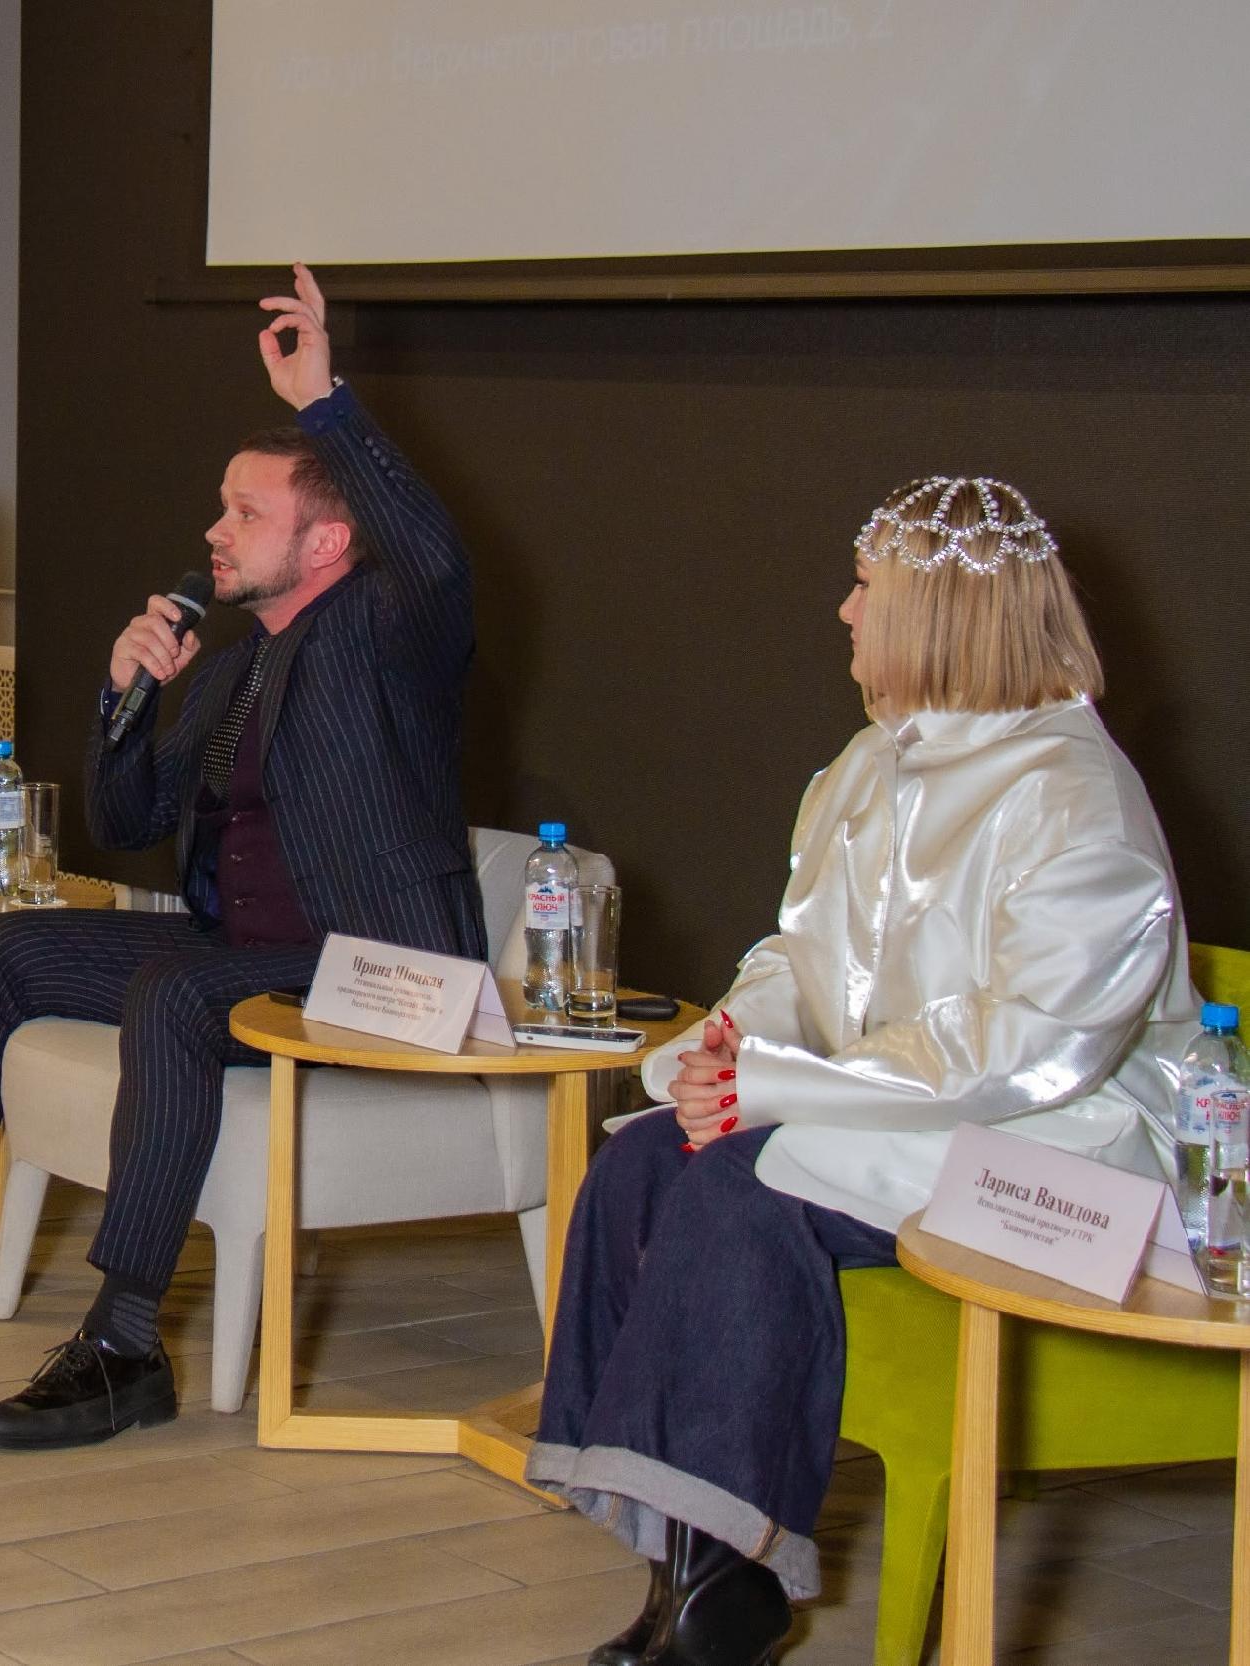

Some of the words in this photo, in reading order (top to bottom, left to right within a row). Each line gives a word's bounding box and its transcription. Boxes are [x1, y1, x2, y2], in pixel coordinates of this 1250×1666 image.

[352, 955, 392, 977] Ирина
[395, 965, 444, 989] Шоцкая
[974, 1168, 1031, 1202] Лариса
[1033, 1186, 1110, 1229] Вахидова
